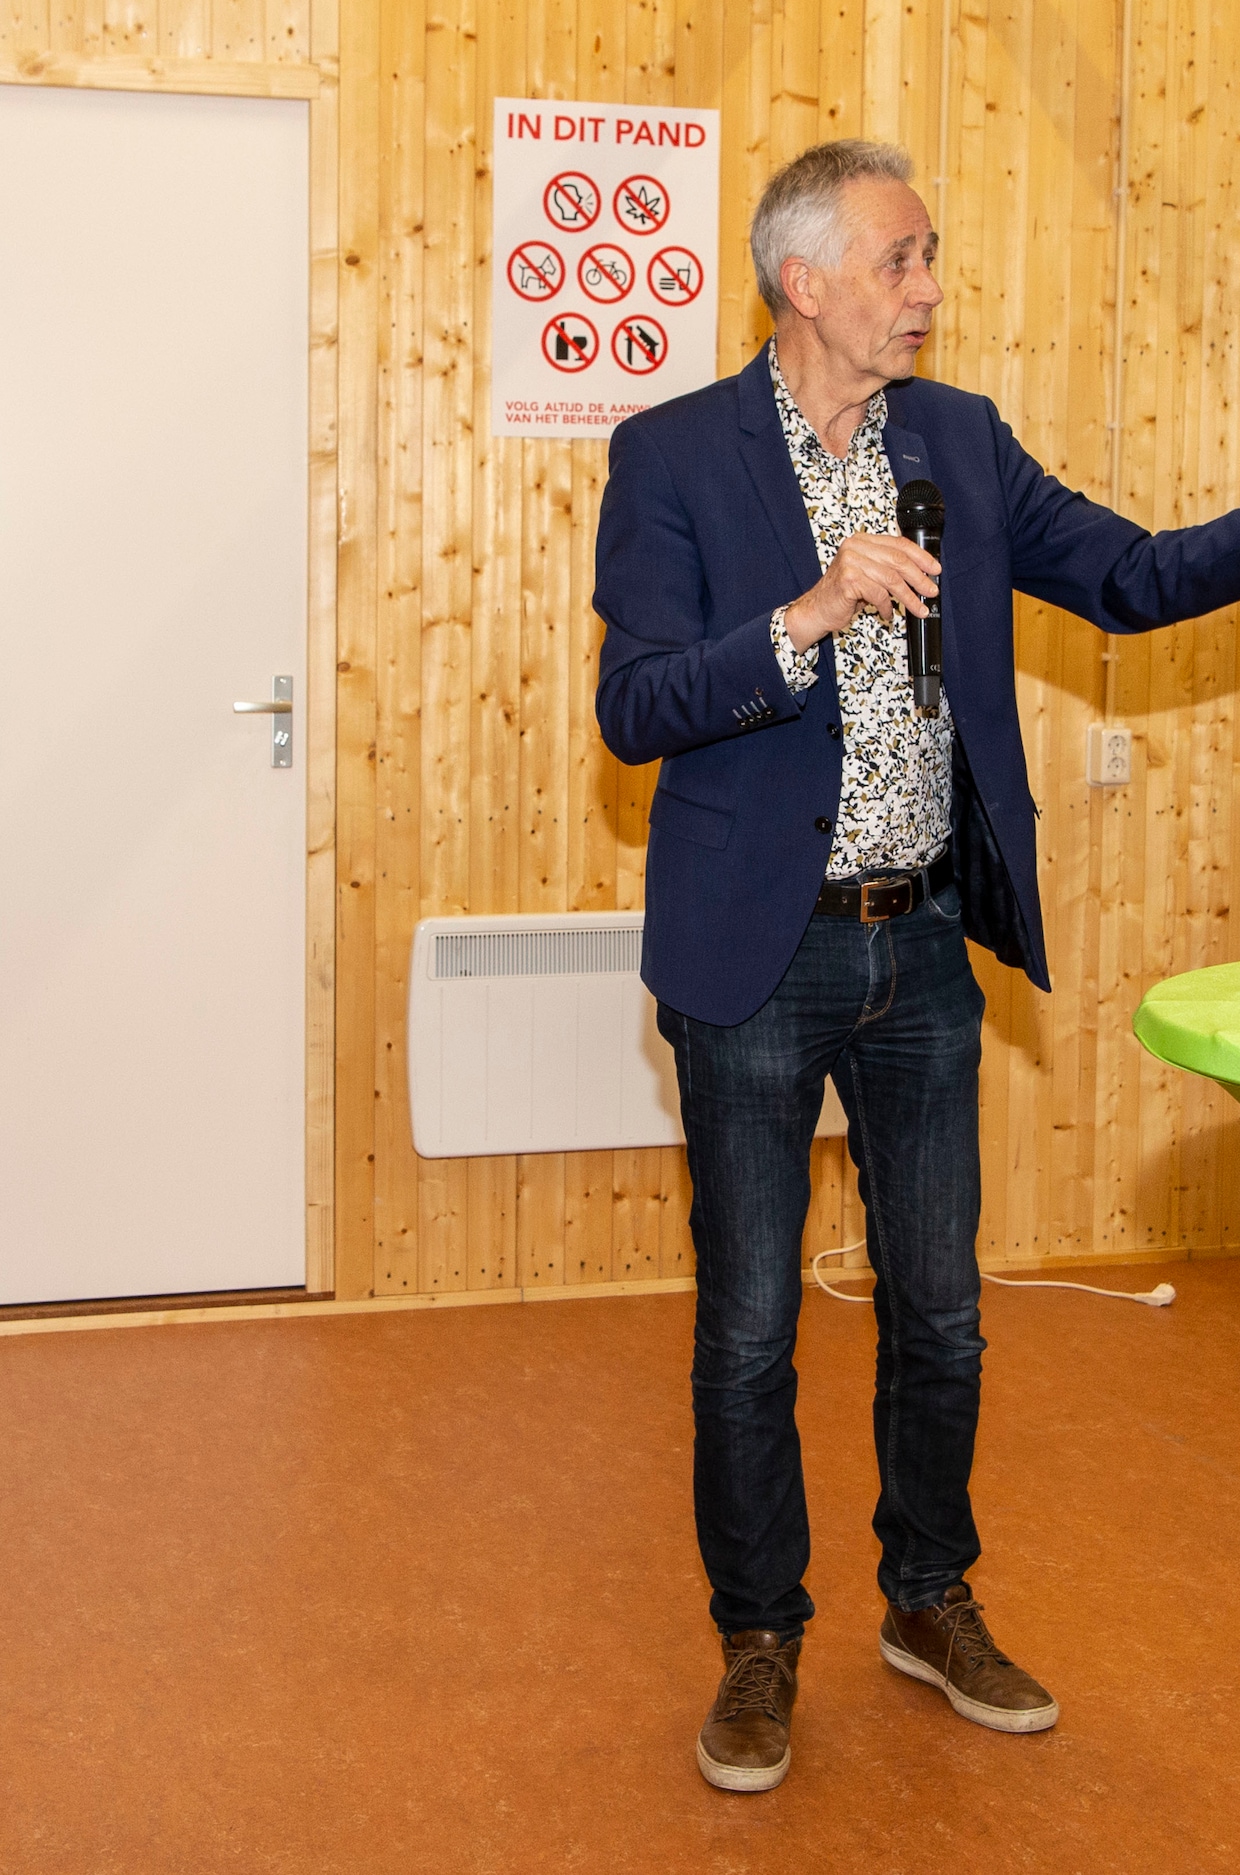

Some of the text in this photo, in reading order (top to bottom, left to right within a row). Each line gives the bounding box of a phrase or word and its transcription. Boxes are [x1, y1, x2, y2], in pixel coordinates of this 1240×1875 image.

[508, 112, 706, 148] IN DIT PAND
[505, 401, 651, 413] VOLG ALTIJD DE AANW
[505, 413, 532, 423] VAN
[535, 414, 558, 424] HET
